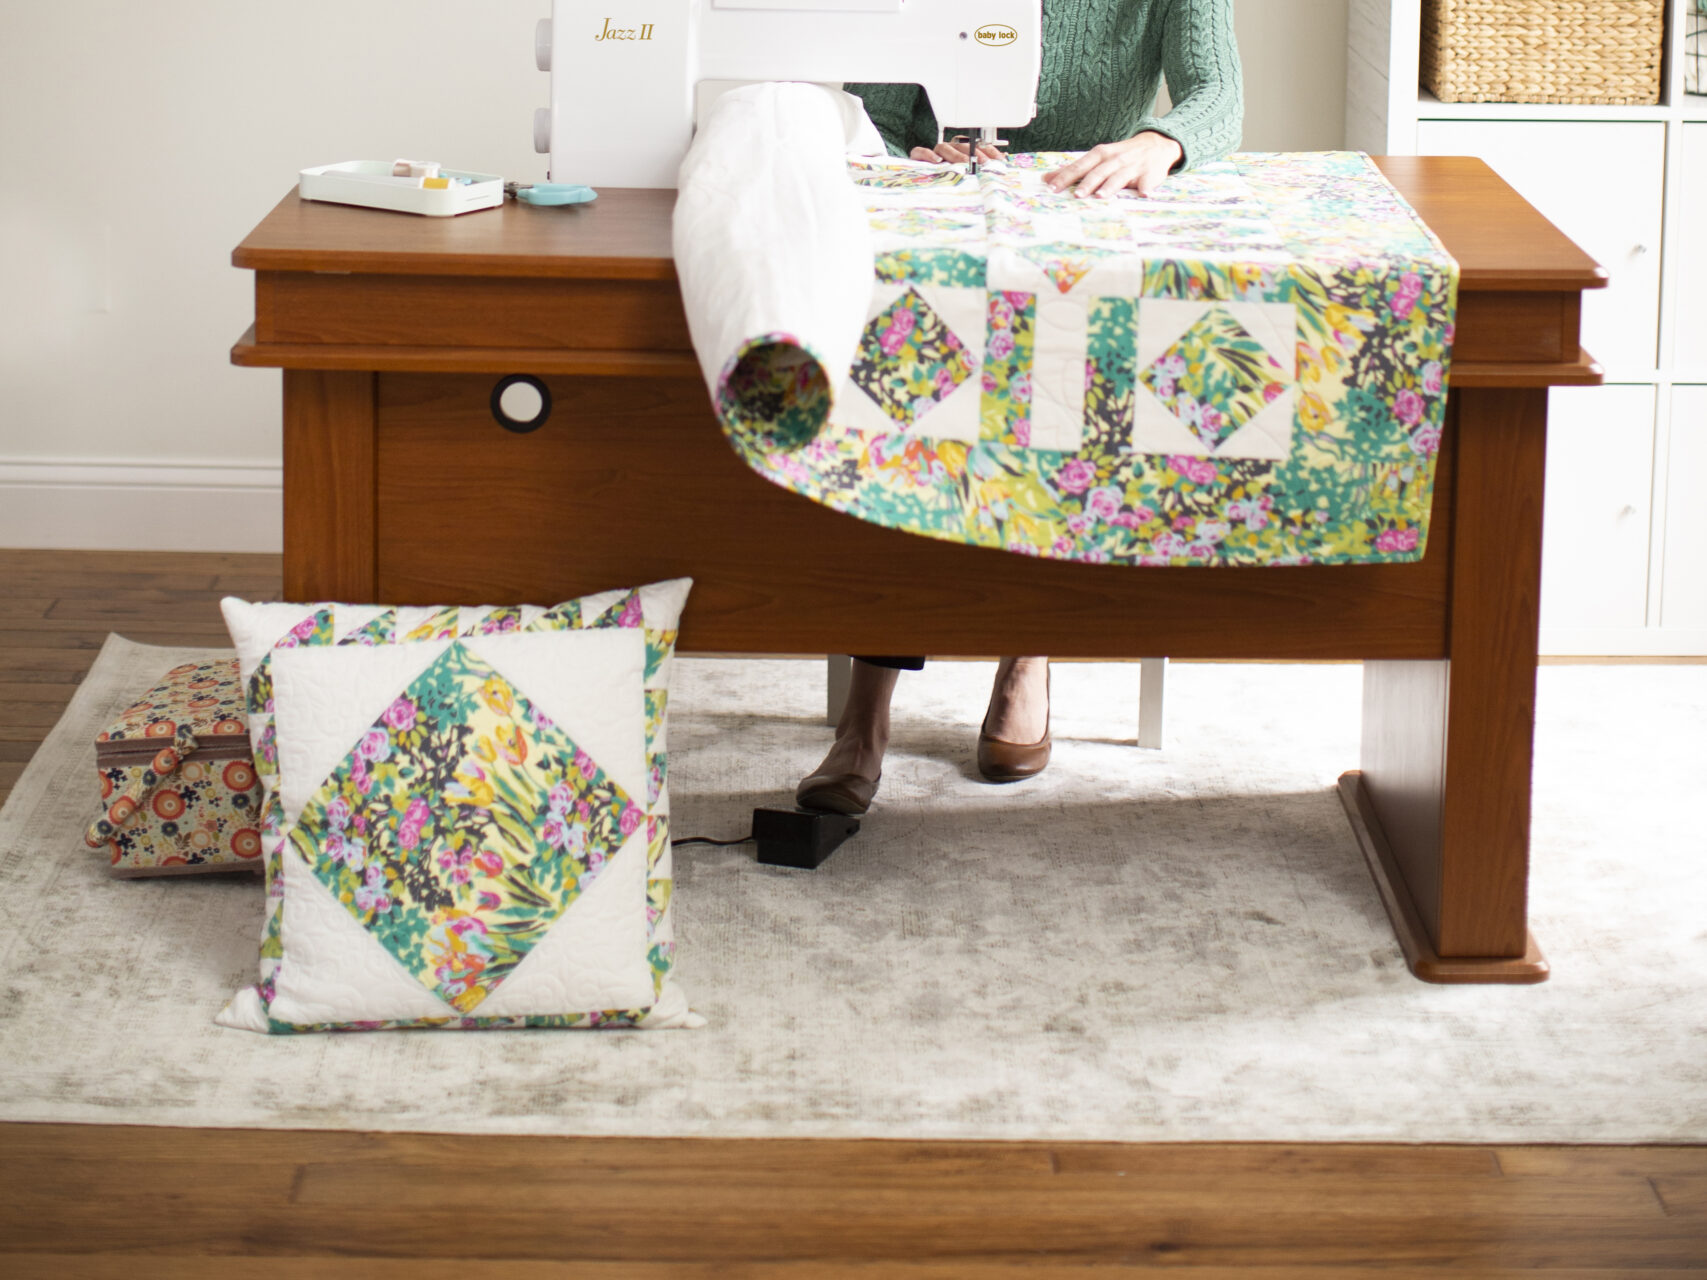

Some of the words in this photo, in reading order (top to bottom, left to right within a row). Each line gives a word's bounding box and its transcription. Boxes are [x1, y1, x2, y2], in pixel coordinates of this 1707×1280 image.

[594, 17, 635, 41] Jazz
[639, 23, 654, 40] II
[978, 31, 996, 40] baby
[999, 31, 1014, 39] lock
